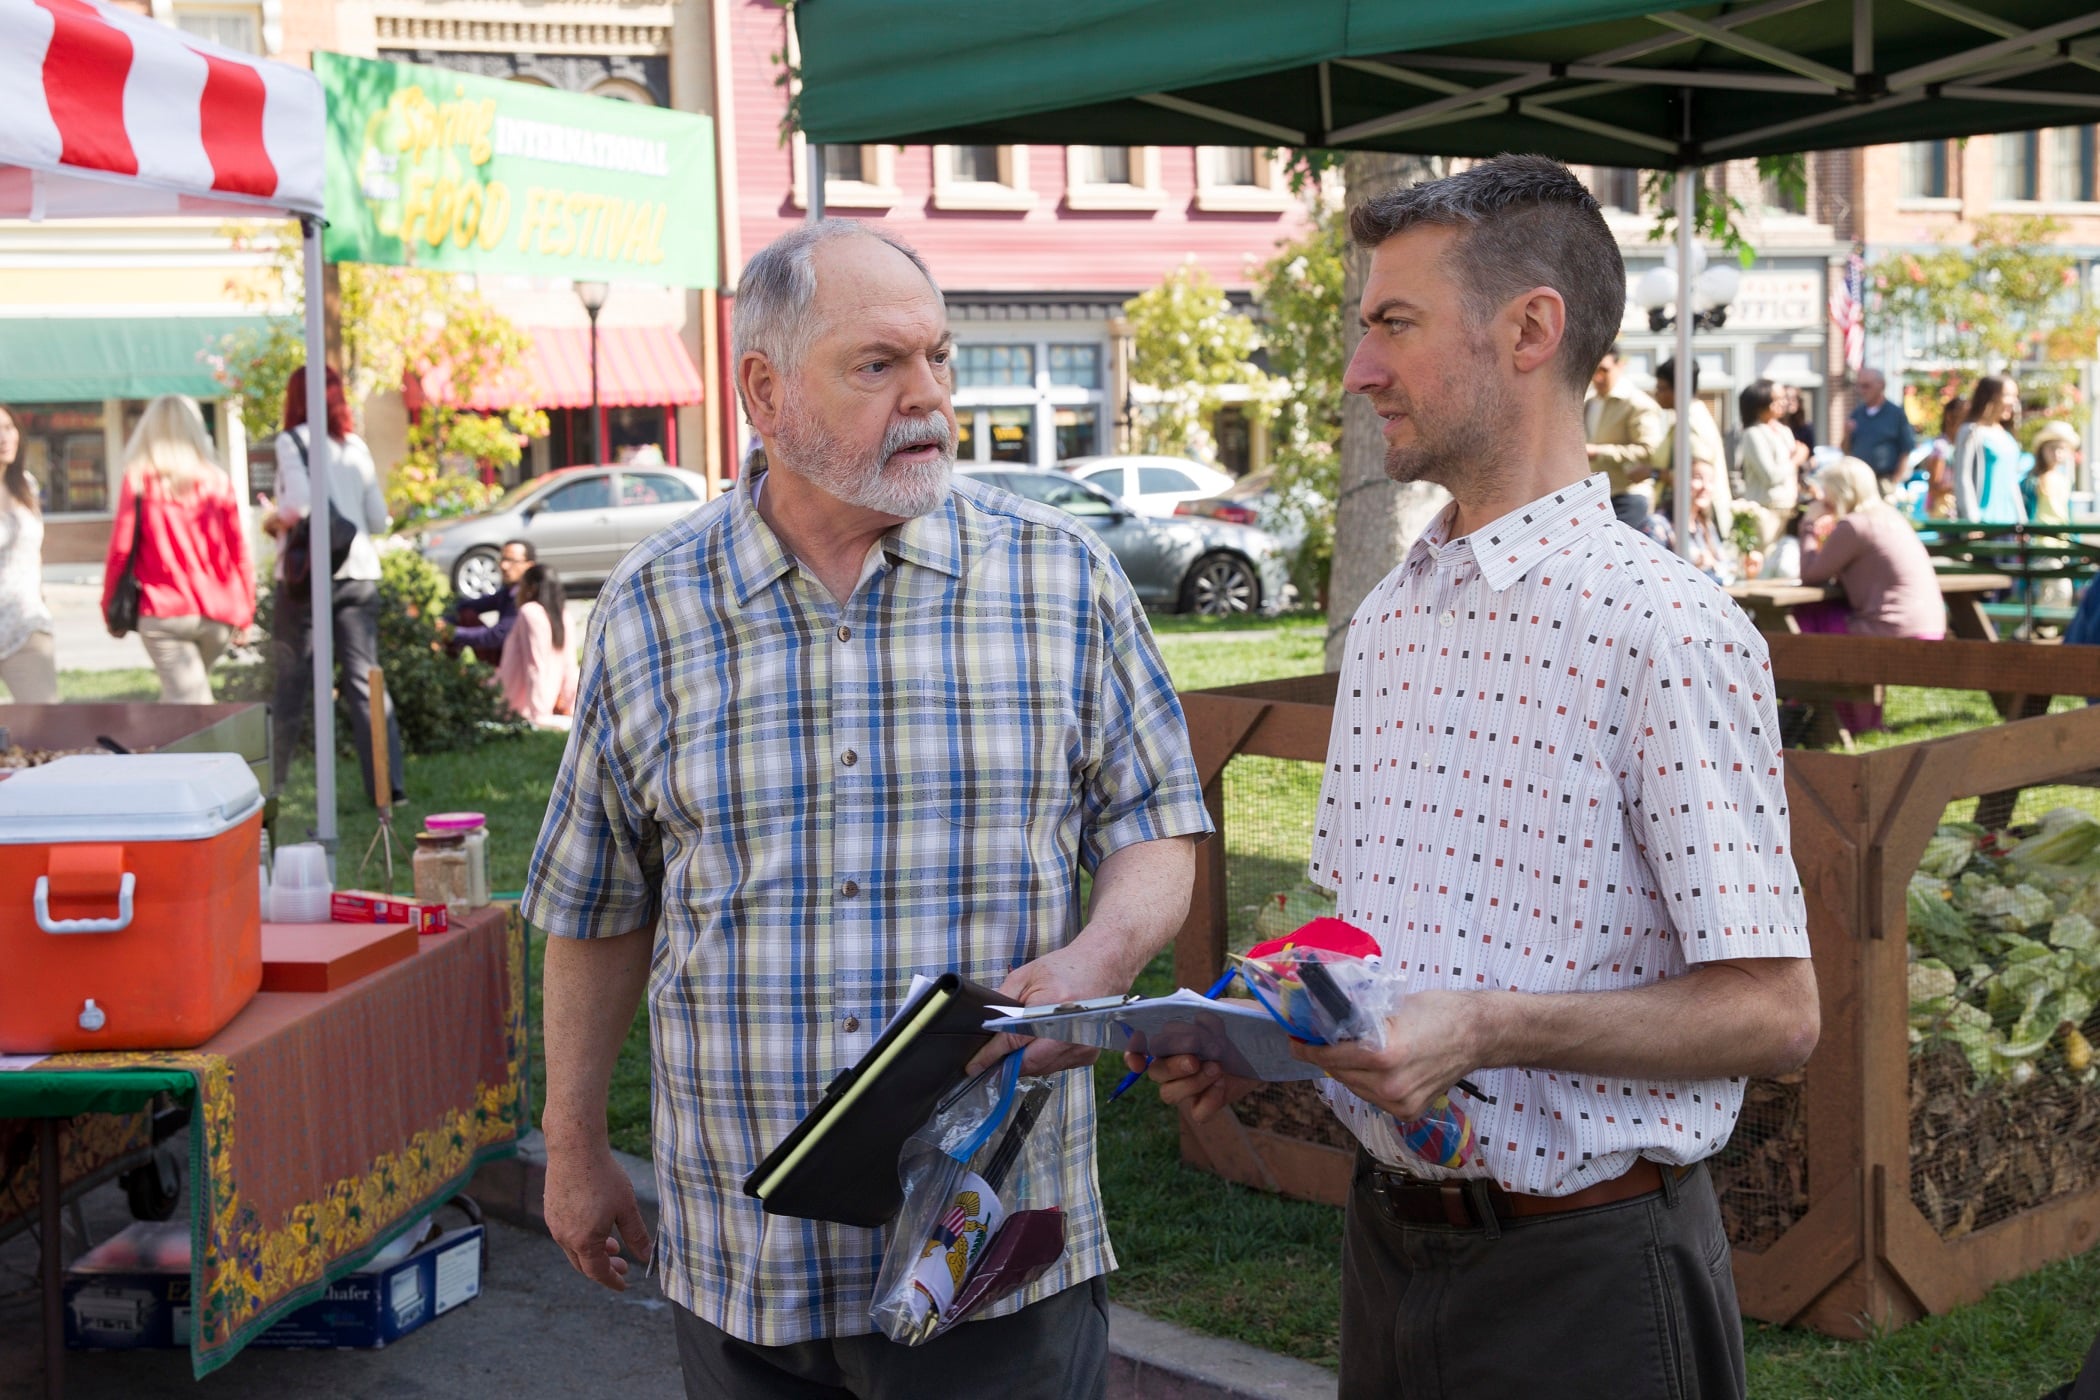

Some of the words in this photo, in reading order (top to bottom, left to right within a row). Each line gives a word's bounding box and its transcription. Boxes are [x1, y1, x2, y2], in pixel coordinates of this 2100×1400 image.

[394, 84, 496, 166] Spring
[495, 115, 669, 176] INTERNATIONAL
[399, 174, 510, 251] FOOD
[518, 186, 668, 265] FESTIVAL
[325, 1283, 371, 1301] hafer
